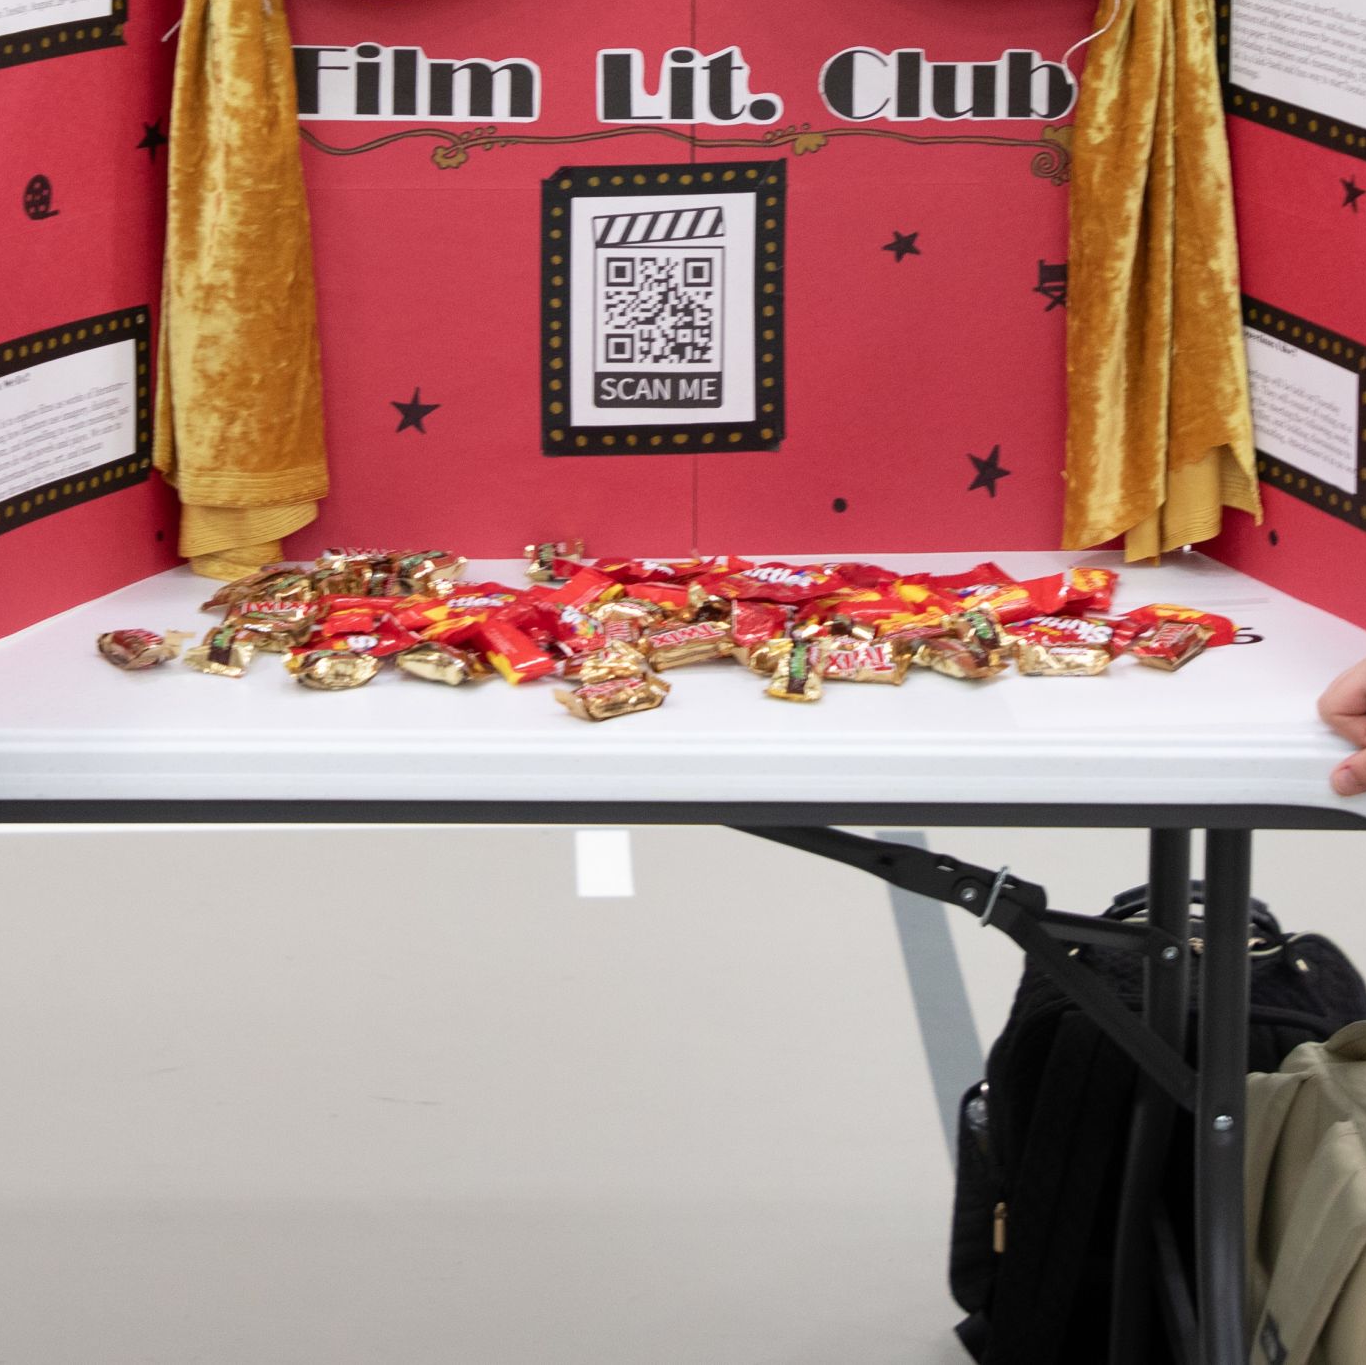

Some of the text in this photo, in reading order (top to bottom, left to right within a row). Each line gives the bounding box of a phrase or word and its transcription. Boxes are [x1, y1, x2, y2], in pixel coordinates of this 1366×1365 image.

[293, 44, 1074, 120] Film Lit. Club
[600, 376, 718, 401] SCAN ME
